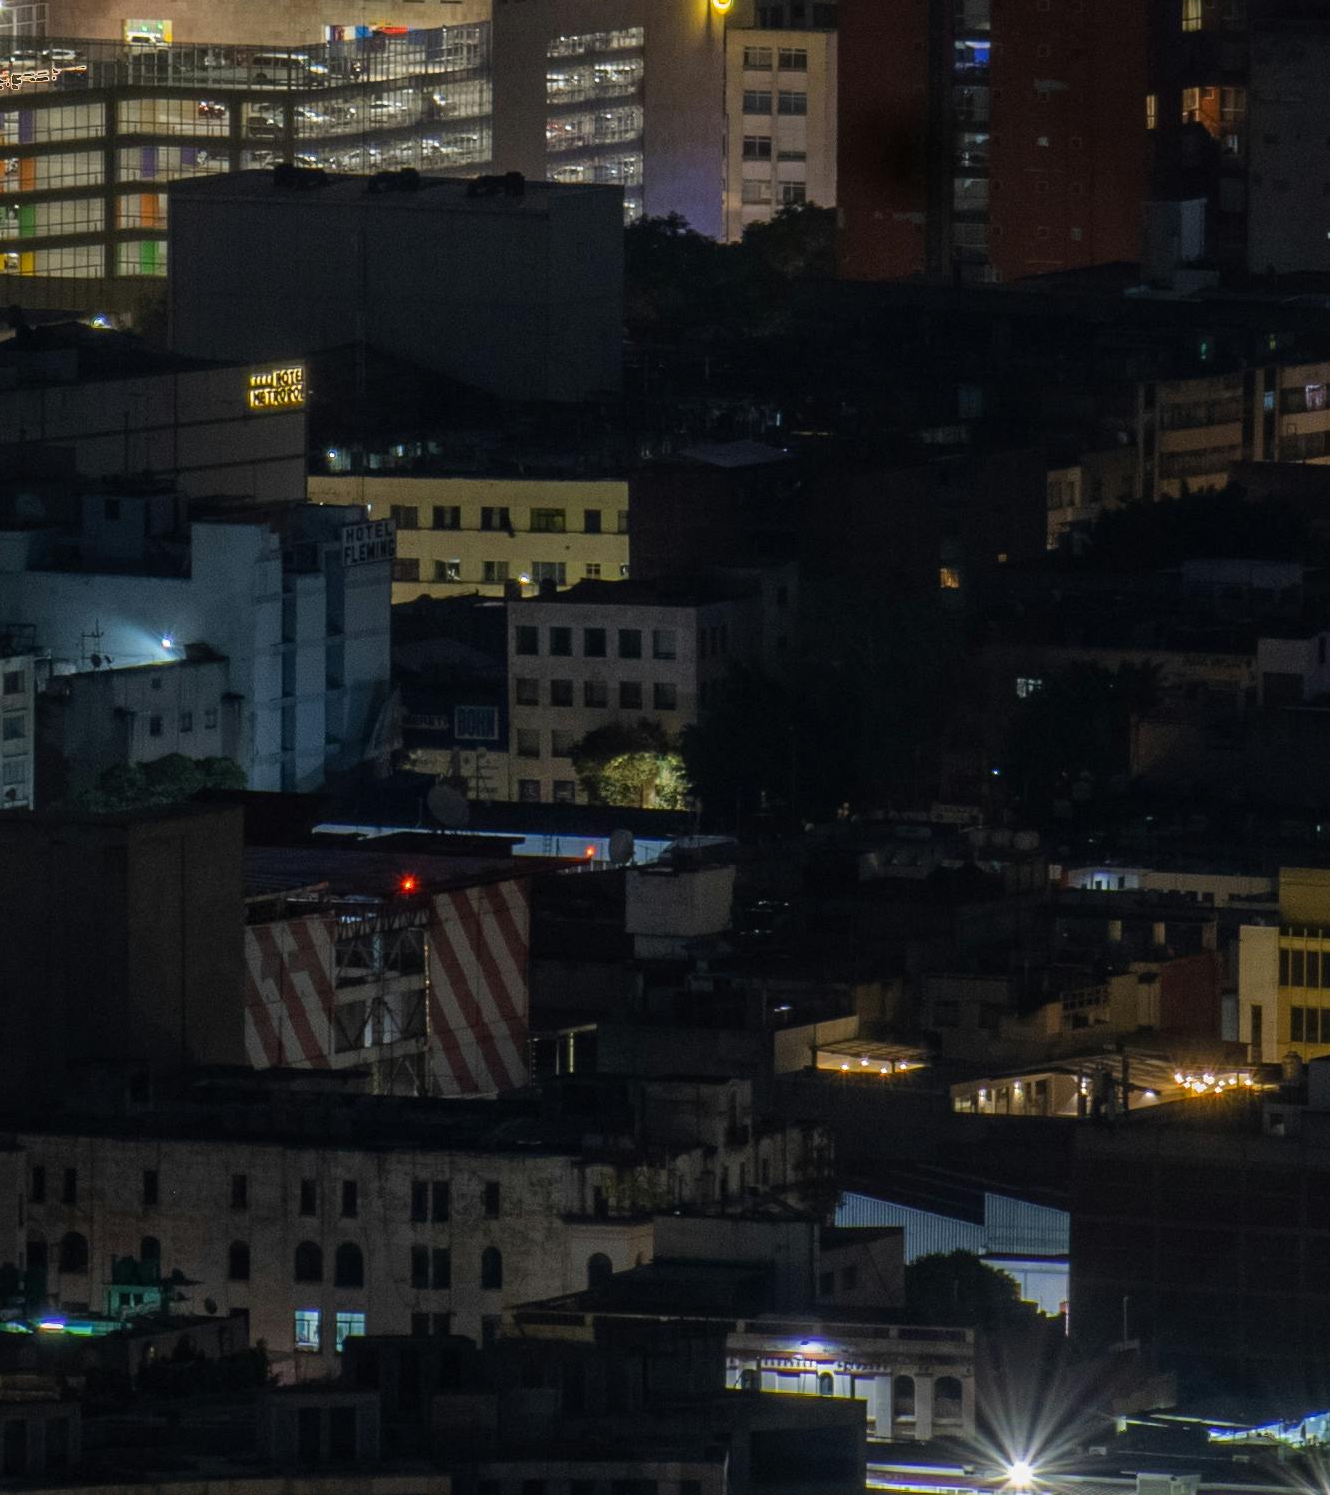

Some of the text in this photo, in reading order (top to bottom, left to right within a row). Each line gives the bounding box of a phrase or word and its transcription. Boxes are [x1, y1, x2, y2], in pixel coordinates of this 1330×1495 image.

[273, 368, 304, 386] HOTE
[345, 522, 393, 543] HOTEL
[344, 540, 395, 566] FLEMING
